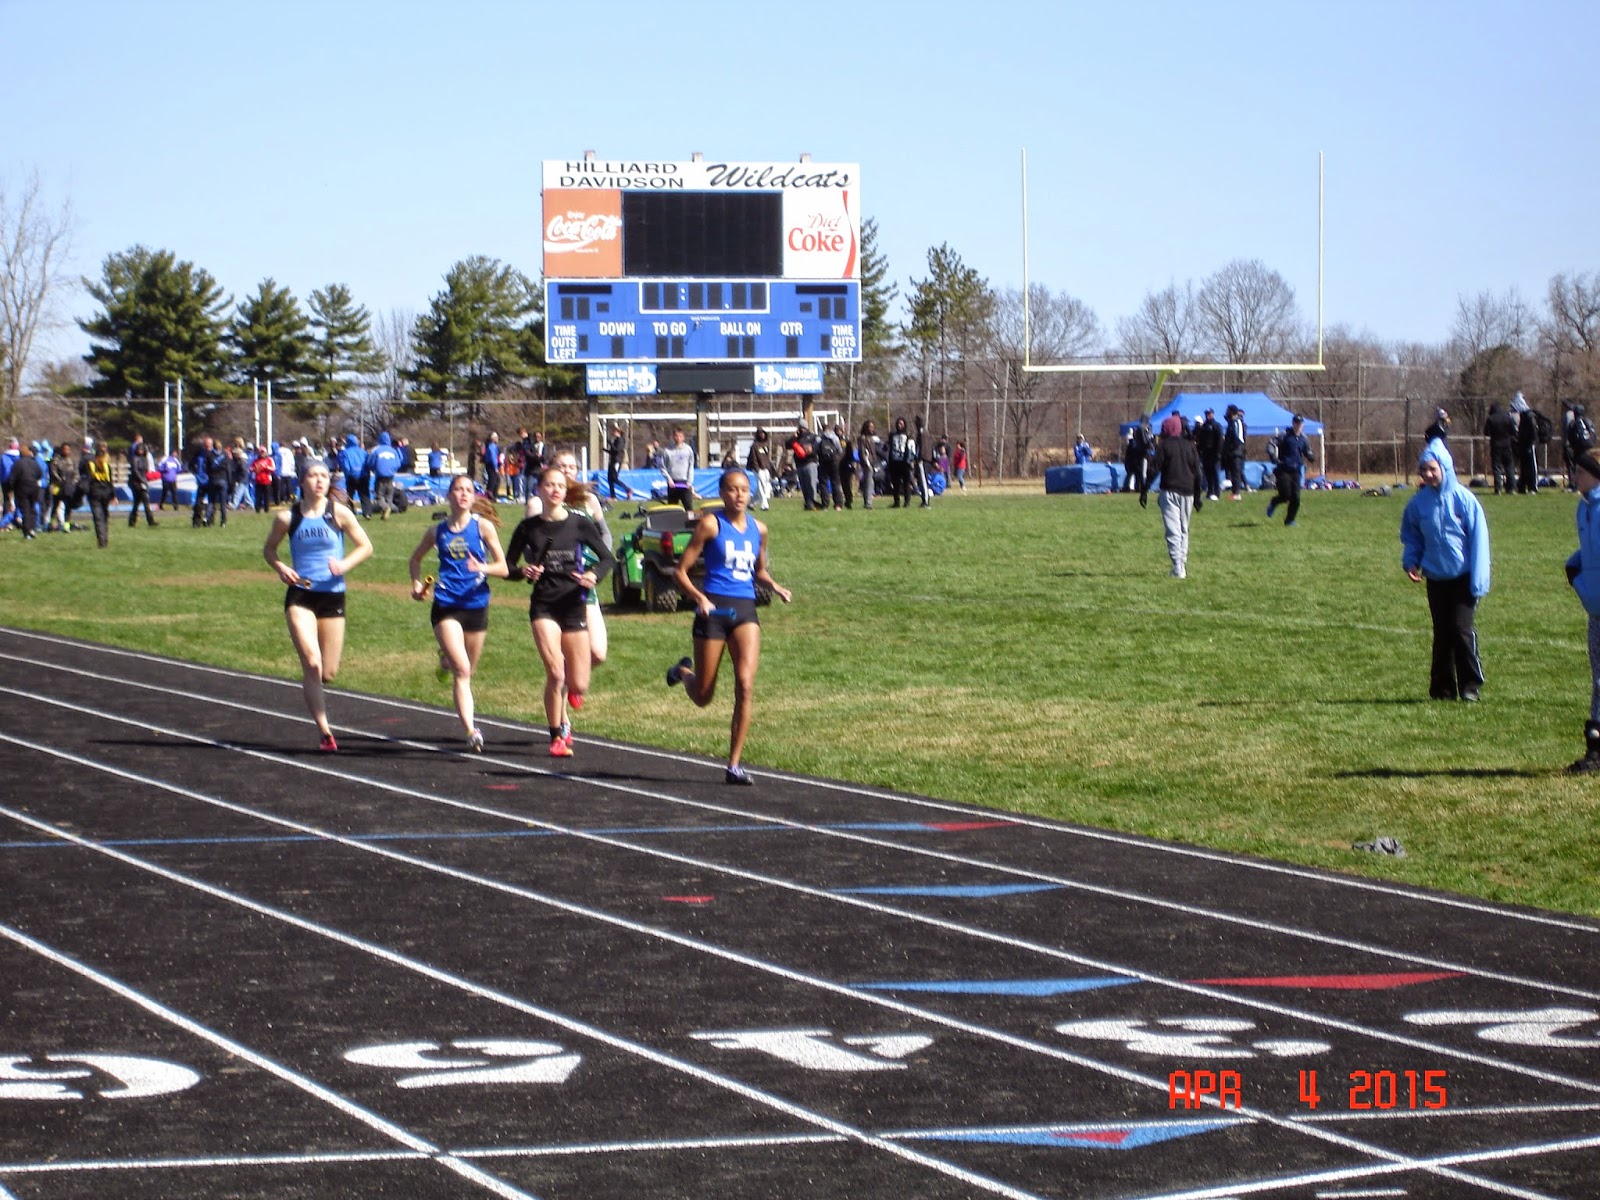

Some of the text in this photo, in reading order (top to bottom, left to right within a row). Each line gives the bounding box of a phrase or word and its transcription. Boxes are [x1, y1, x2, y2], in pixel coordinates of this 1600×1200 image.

[566, 161, 677, 174] HILLIARD
[560, 176, 684, 188] DAVIDSON
[706, 163, 850, 188] Wildcats
[788, 228, 844, 252] Coke
[554, 325, 577, 337] TIME
[599, 321, 637, 336] DOWN
[653, 321, 687, 336] TO GO
[720, 321, 761, 336] BALL ON
[780, 321, 804, 336] QTR
[831, 325, 855, 337] TIME
[551, 336, 578, 348] OUTS
[831, 336, 856, 348] OUTS
[553, 348, 577, 359] LEFT
[831, 347, 855, 358] LEFT
[588, 379, 629, 391] WILDCATS
[298, 527, 329, 540] DARBY
[1054, 1018, 1332, 1058] 3
[343, 1040, 581, 1089] 5
